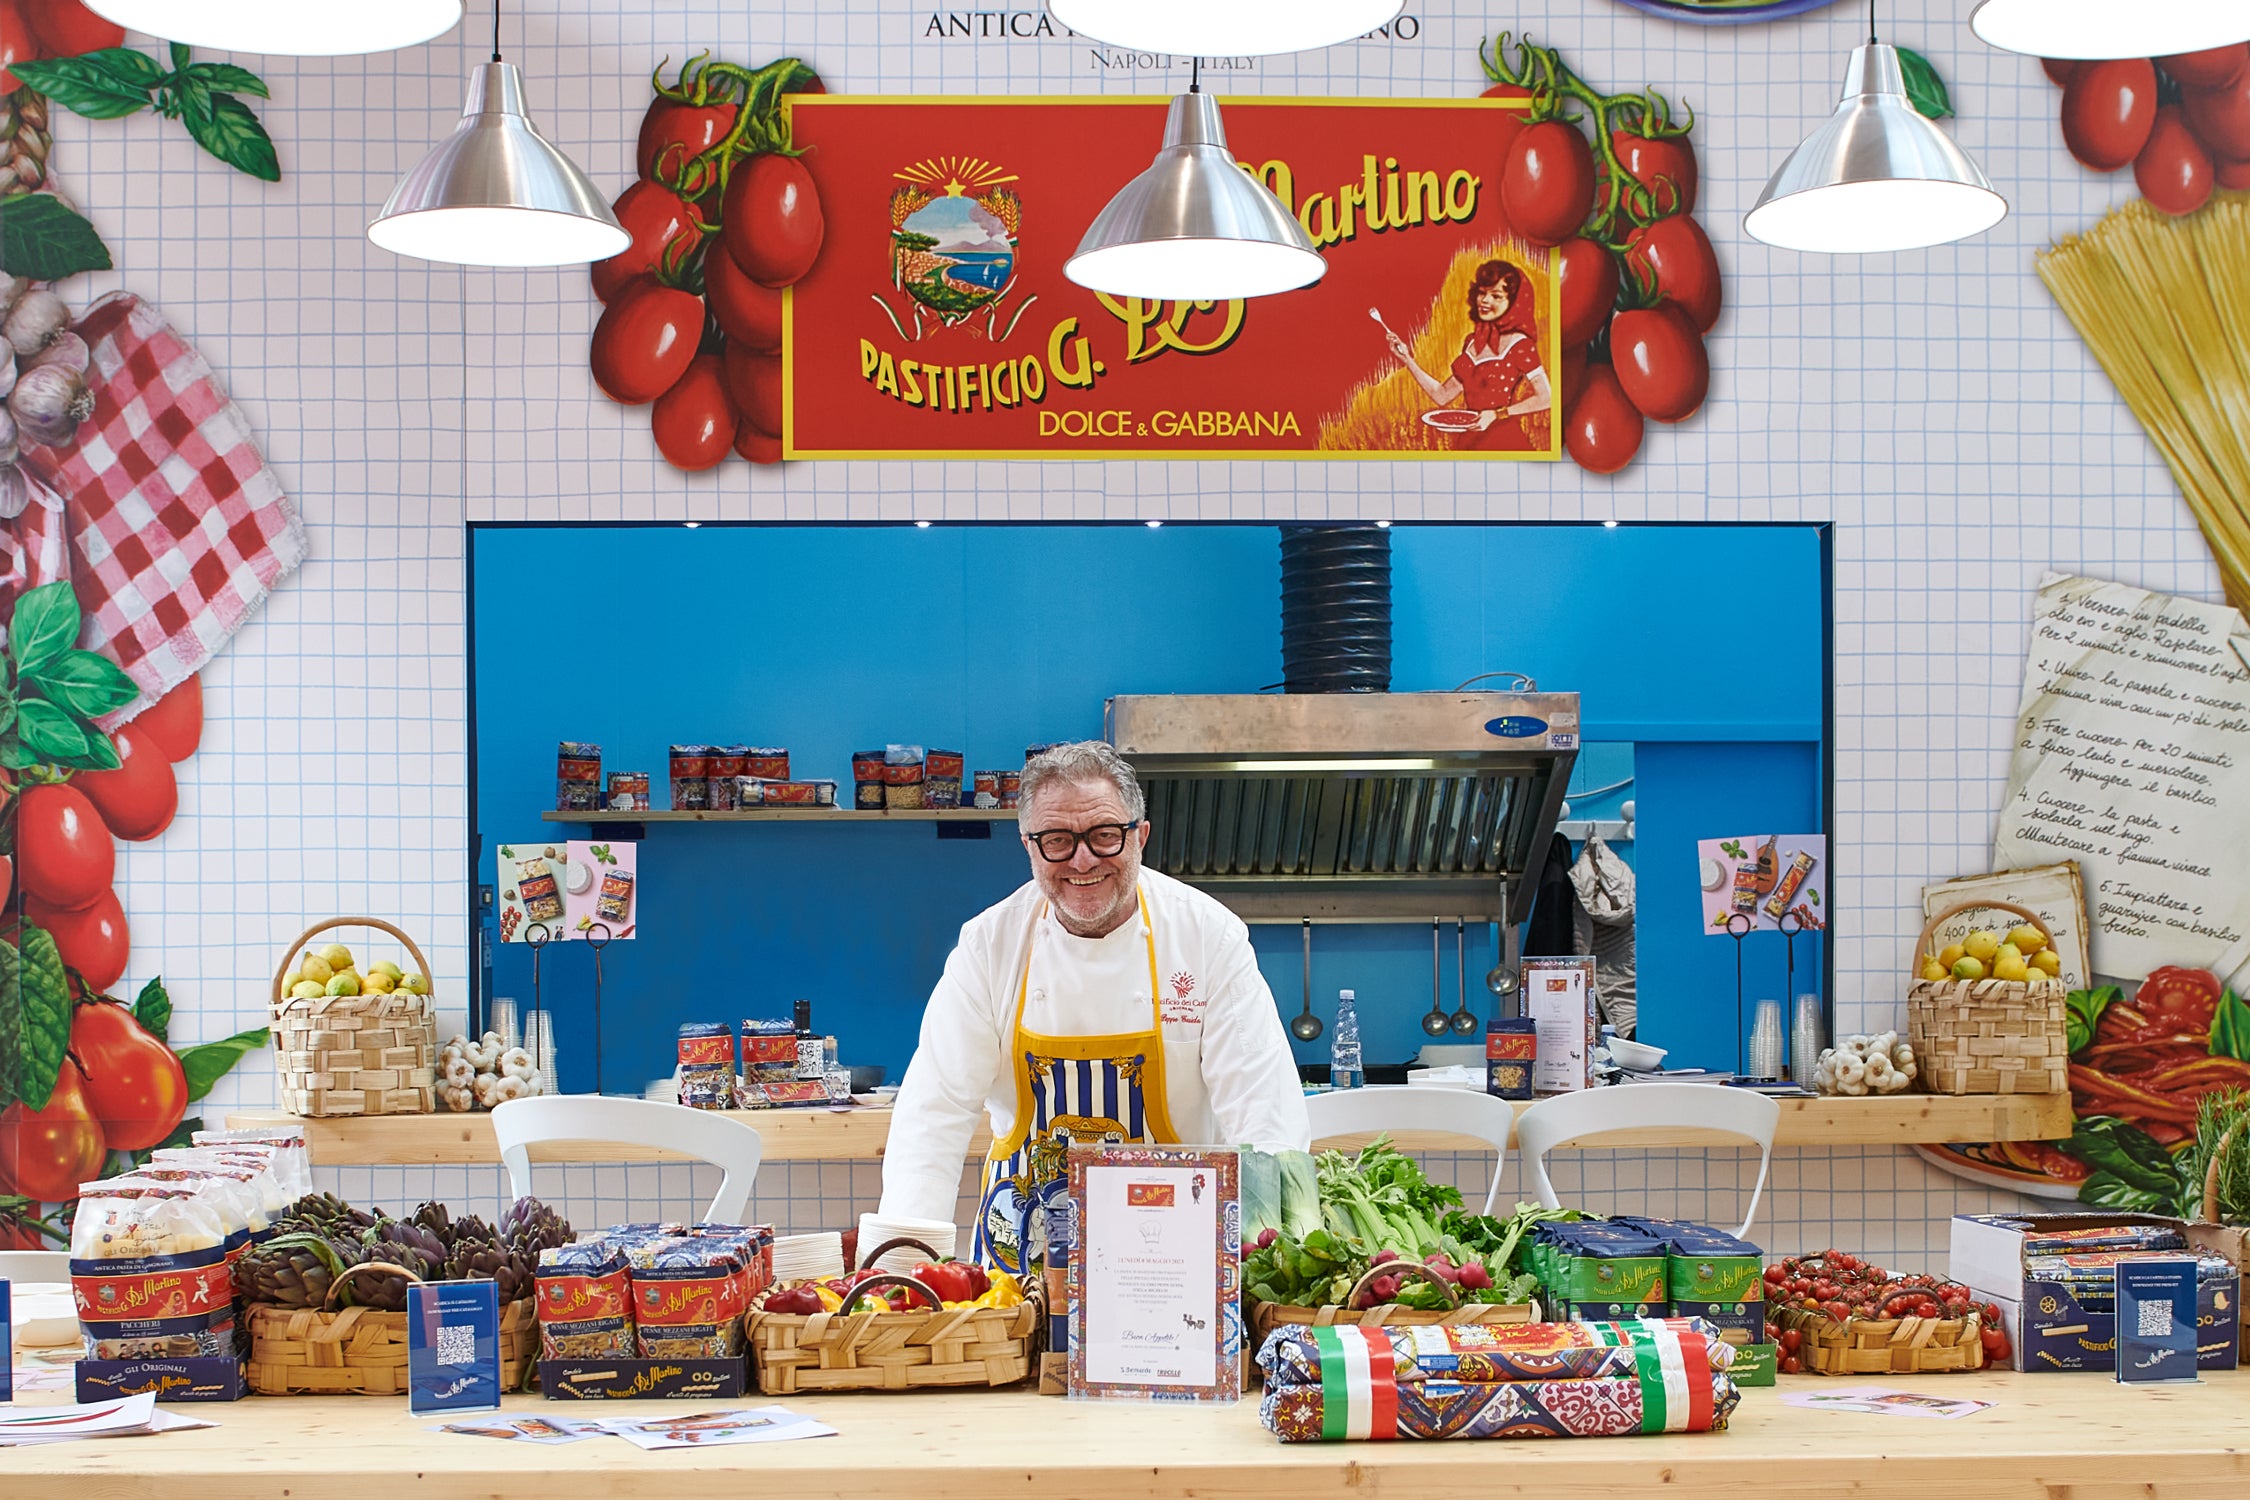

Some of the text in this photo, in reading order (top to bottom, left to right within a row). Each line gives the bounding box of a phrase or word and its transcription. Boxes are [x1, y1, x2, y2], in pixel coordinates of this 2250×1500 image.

[925, 11, 1054, 38] ANTICA
[860, 338, 1046, 410] PASTIFICIO
[1048, 317, 1106, 388] G.
[1039, 410, 1302, 437] DOLCE & GABBANA
[2049, 608, 2074, 623] olio
[2077, 616, 2095, 628] evo
[2101, 620, 2111, 631] e
[2078, 595, 2129, 617] Versare
[2132, 608, 2151, 621] in
[2153, 611, 2210, 635] padella
[2064, 631, 2077, 645] 2
[2076, 638, 2128, 655] minuti
[2129, 649, 2141, 659] e
[2038, 659, 2246, 713] 2. Unire la passata e cuocere
[2099, 694, 2128, 711] viva
[2130, 702, 2156, 718] con
[2155, 708, 2175, 720] un
[2192, 712, 2212, 727] di
[2213, 718, 2250, 733] sale
[2021, 739, 2035, 750] a
[2077, 747, 2117, 765] lento
[2120, 758, 2134, 768] e
[2024, 716, 2040, 731] 3.
[2042, 718, 2071, 738] Far
[2076, 728, 2128, 748] cuocere
[2160, 742, 2183, 758] 20
[2182, 751, 2235, 769] minuti
[2060, 761, 2133, 791] Aggiungere
[2139, 781, 2160, 794] il
[2018, 786, 2181, 835] 4. Cuocere la pasta e
[2022, 807, 2087, 831] scolarla
[2089, 824, 2117, 838] nel
[2015, 825, 2096, 855] Mantecare
[2098, 846, 2112, 857] a
[2117, 846, 2171, 870] fiamma
[2100, 880, 2205, 916] 5. Impiattare e
[1944, 925, 1966, 941] 400
[2165, 917, 2190, 930] con
[2190, 919, 2243, 944] basilico
[143, 1277, 182, 1305] Martino
[681, 1285, 713, 1311] Martino
[120, 1320, 161, 1329] PACCHERI
[551, 1318, 620, 1331] PENNE MEZZANI RIGATE
[663, 1326, 690, 1334] MEZZANI
[691, 1325, 714, 1333] RIGATE
[2077, 1337, 2109, 1352] PASTIFICIO
[124, 1362, 188, 1375] GLI ORIGINALI
[649, 1366, 683, 1391] Martino
